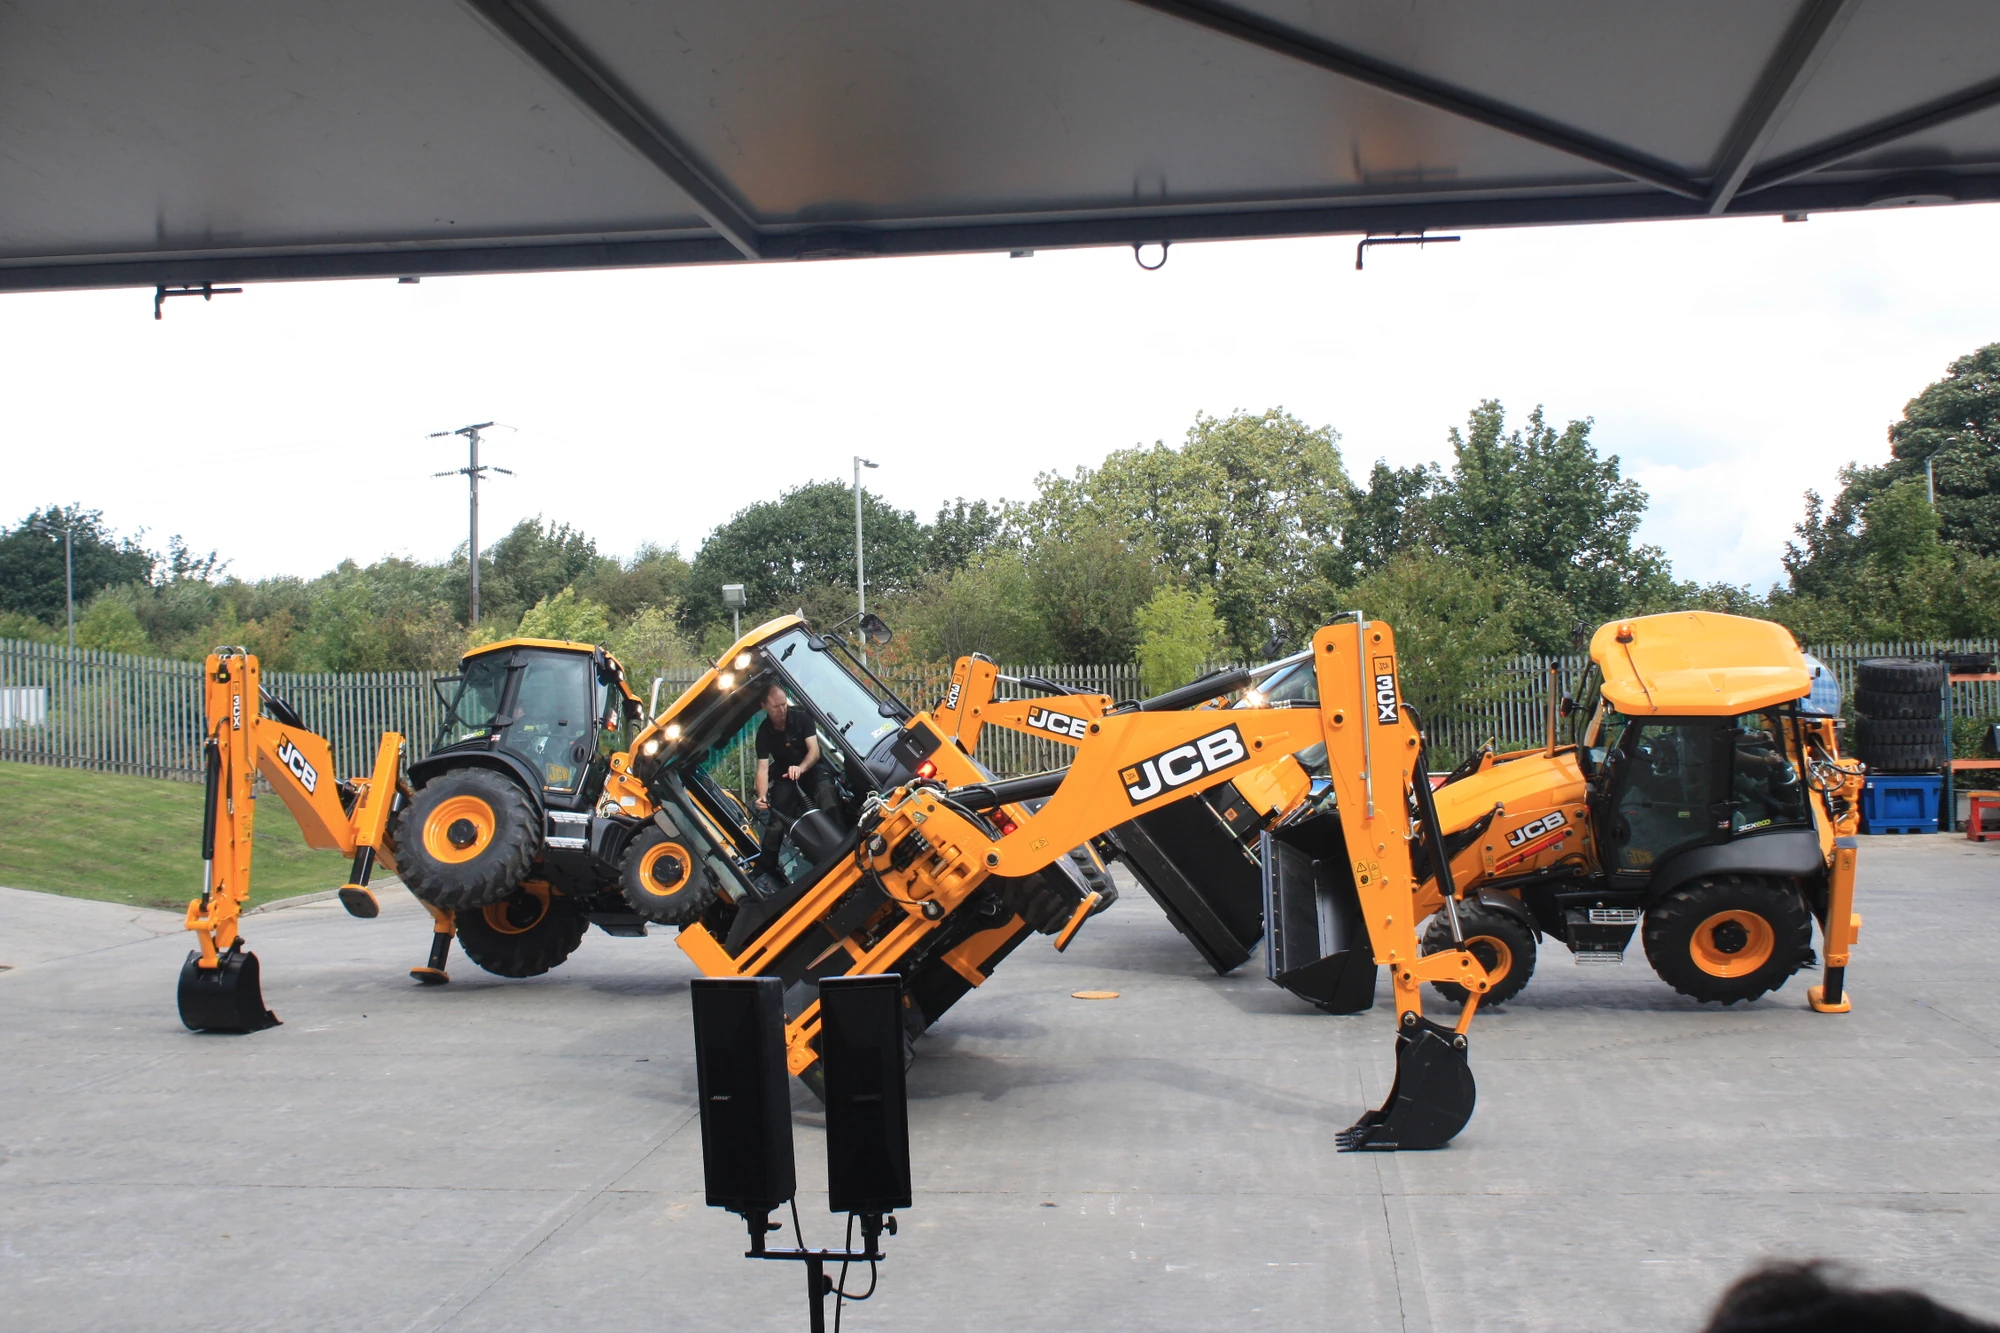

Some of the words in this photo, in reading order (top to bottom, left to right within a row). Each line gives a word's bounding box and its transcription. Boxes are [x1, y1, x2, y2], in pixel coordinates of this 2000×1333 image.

[947, 684, 960, 709] 3CX
[1376, 675, 1397, 721] 3CX
[279, 742, 317, 793] JCB
[548, 764, 568, 781] JCB
[1128, 729, 1244, 801] JCB
[1509, 811, 1566, 847] JCB
